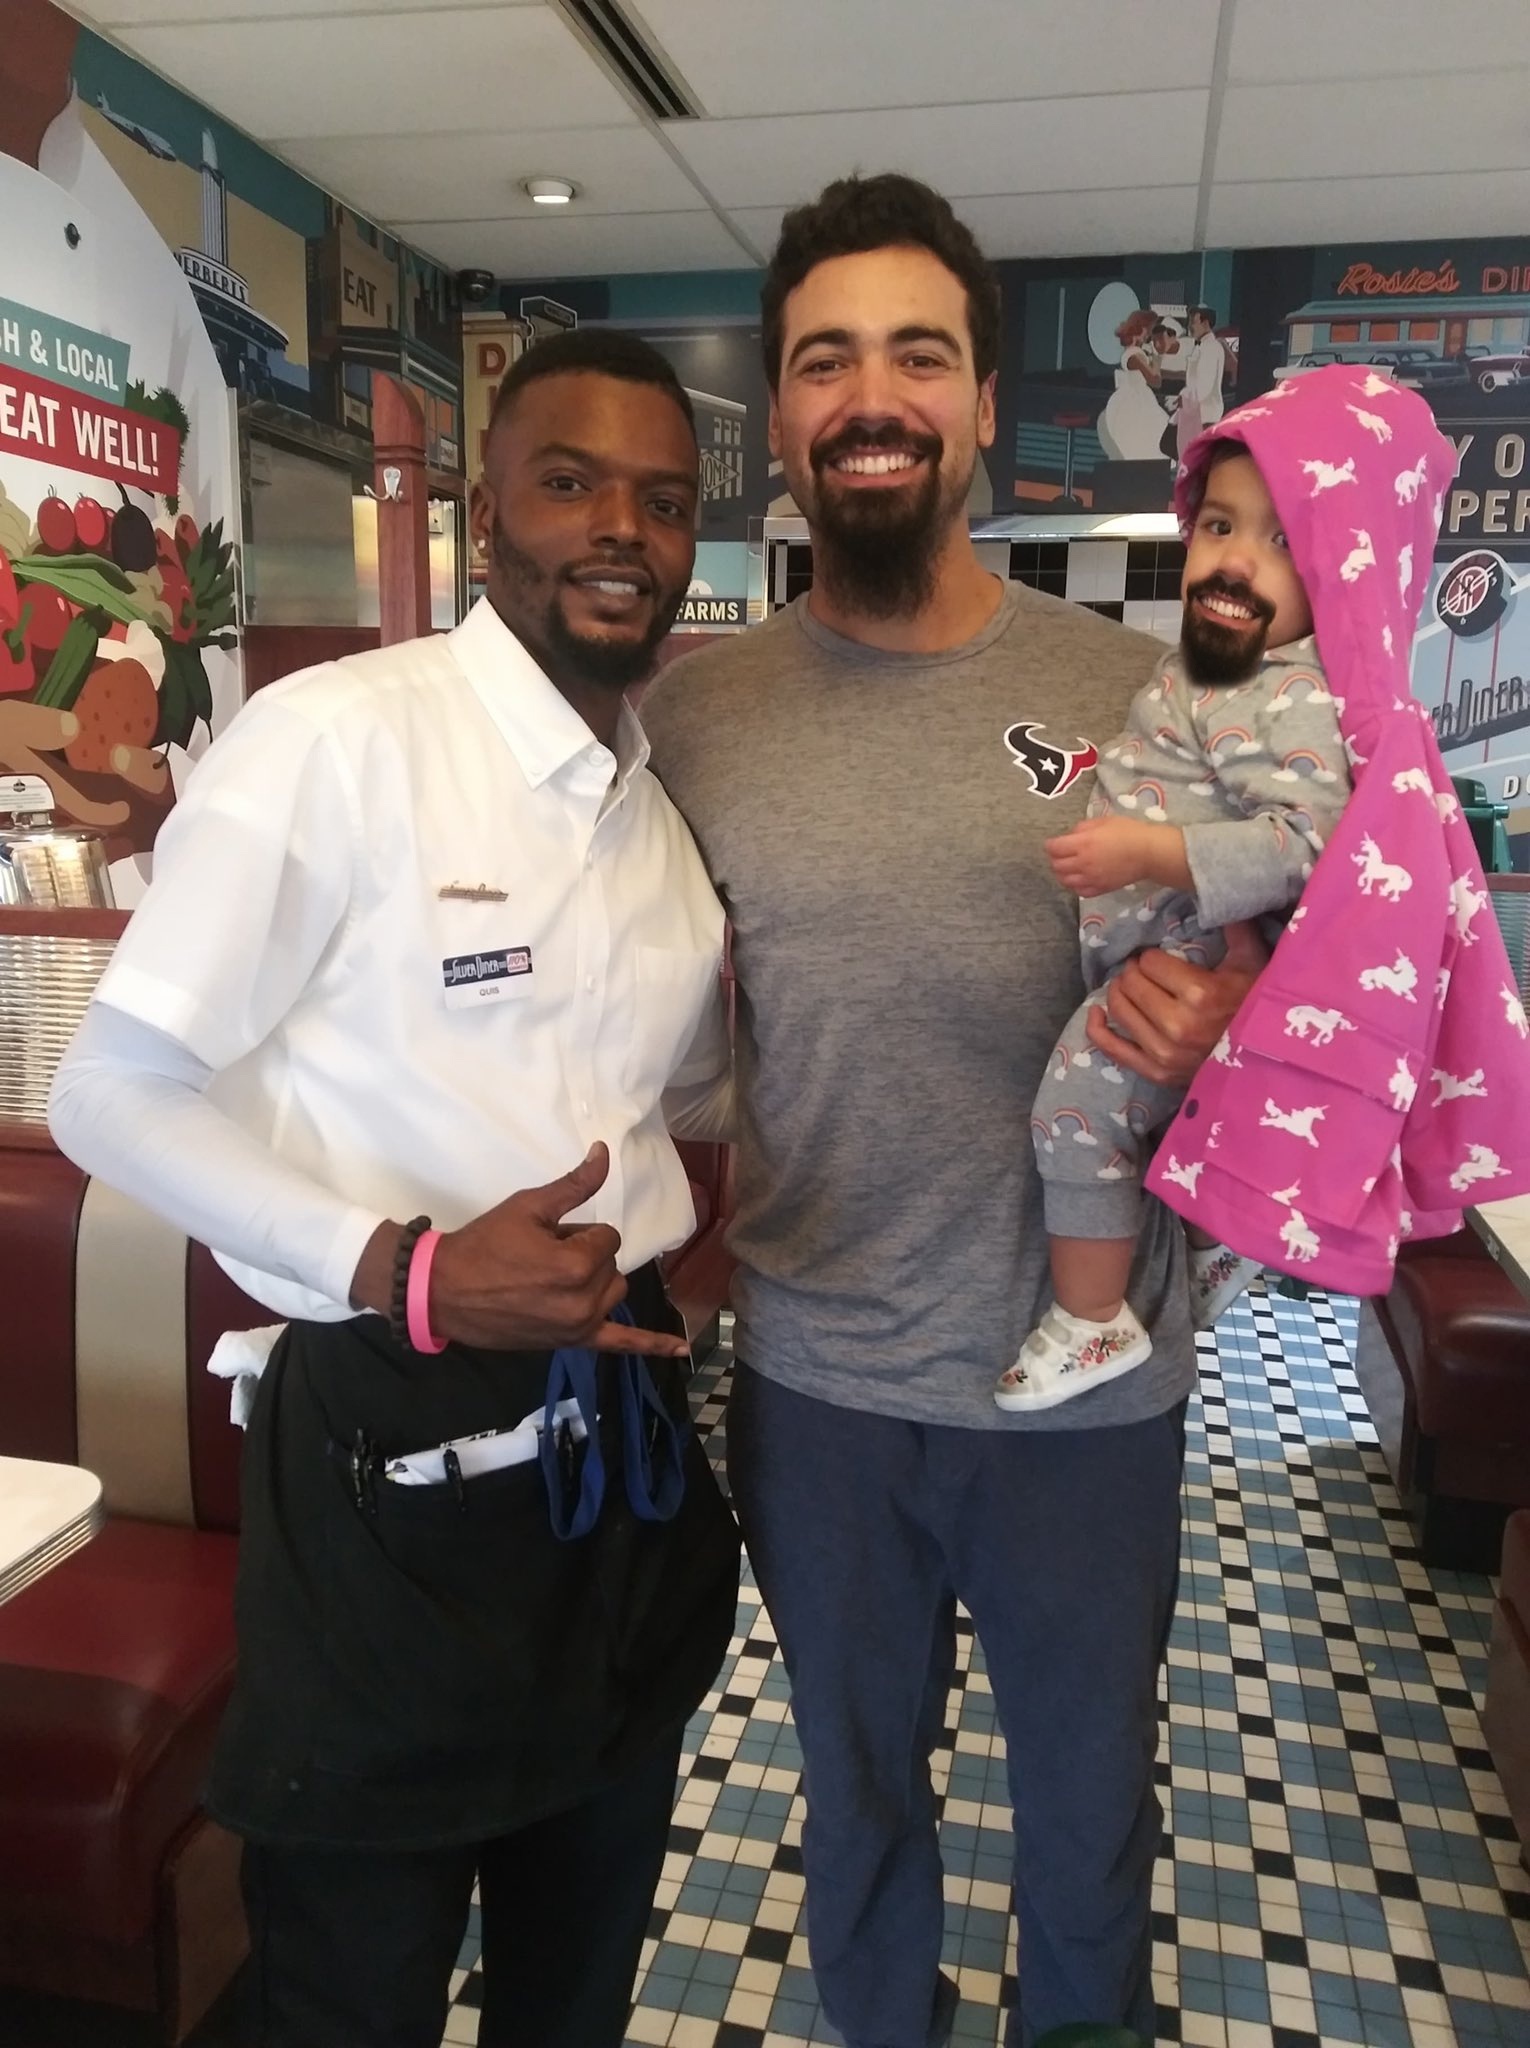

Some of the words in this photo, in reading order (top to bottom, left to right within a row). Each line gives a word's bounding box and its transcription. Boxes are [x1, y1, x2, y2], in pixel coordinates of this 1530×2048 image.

[344, 266, 377, 317] EAT
[1337, 259, 1460, 296] Rosie's
[30, 329, 48, 367] &
[55, 337, 120, 392] LOCAL
[0, 382, 60, 449] EAT
[71, 405, 159, 477] WELL!
[479, 986, 500, 997] QUIS
